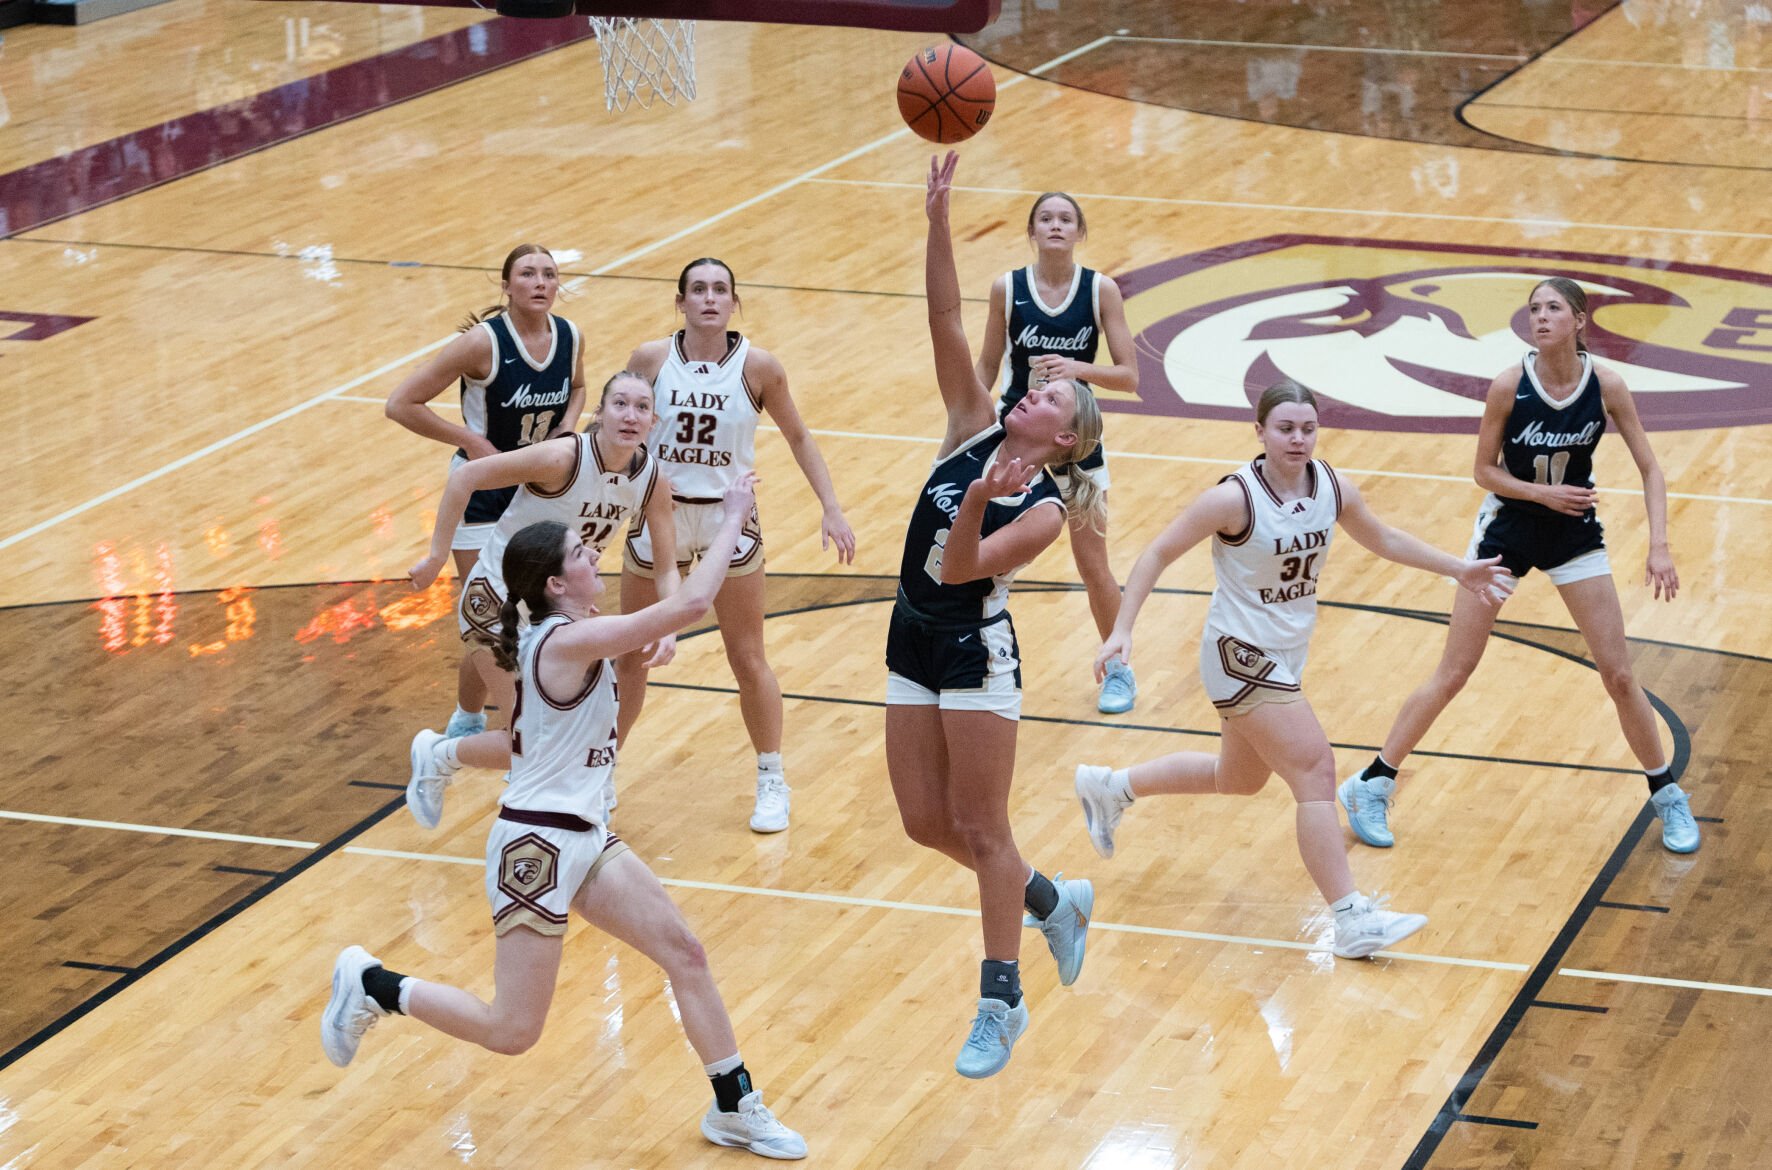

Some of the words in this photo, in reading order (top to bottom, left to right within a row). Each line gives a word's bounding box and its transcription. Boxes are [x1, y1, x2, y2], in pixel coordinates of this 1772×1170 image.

[1015, 324, 1093, 351] Norwell
[669, 389, 730, 411] LADY
[676, 411, 717, 446] 32
[1512, 420, 1601, 448] Norwell
[658, 443, 732, 467] EAGLES
[578, 502, 629, 521] LADY
[1273, 528, 1329, 556] LADY
[1258, 581, 1316, 604] EAGL
